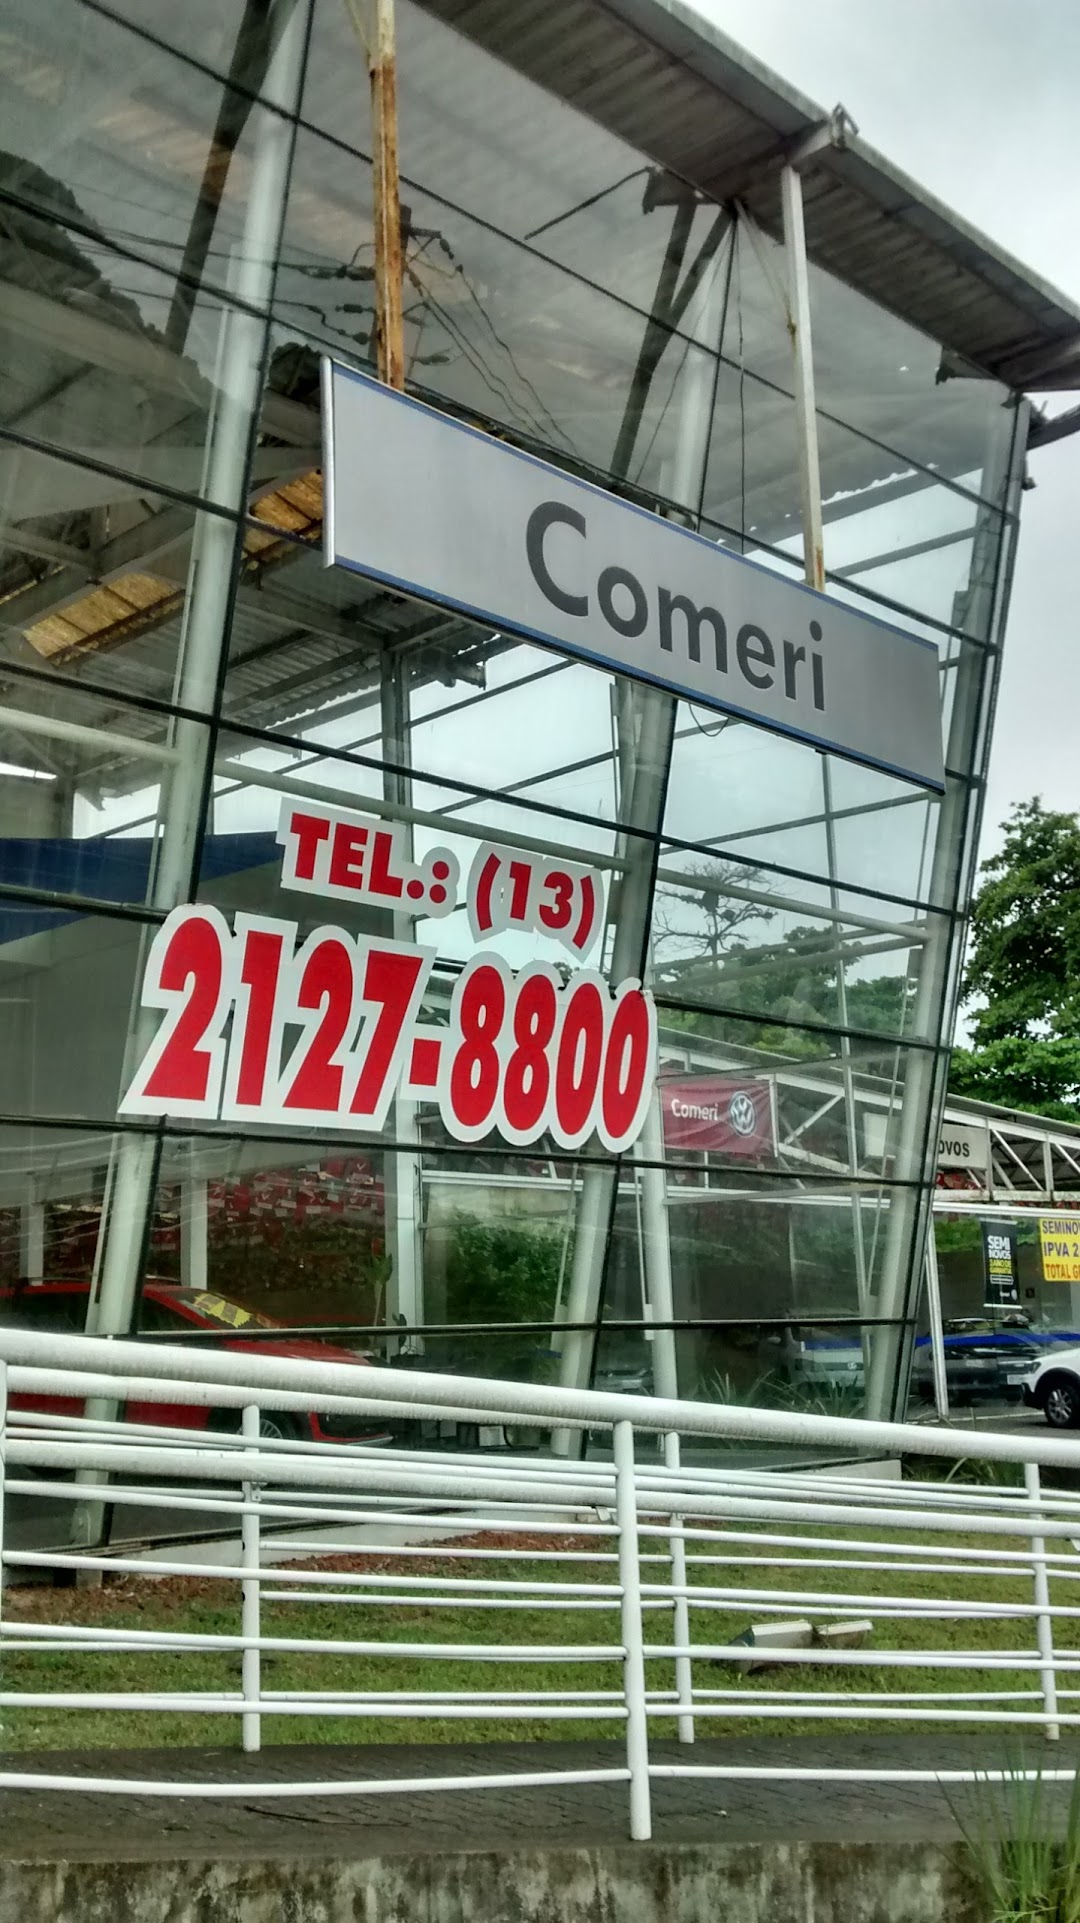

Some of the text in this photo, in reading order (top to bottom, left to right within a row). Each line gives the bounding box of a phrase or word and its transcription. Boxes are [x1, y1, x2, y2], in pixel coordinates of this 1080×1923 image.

[526, 501, 825, 711] Comeri
[290, 812, 595, 950] TEL.: (13)
[142, 917, 649, 1139] 2127-8800
[671, 1098, 719, 1121] Comeri
[1042, 1220, 1080, 1236] SEMINO
[988, 1235, 1011, 1251] SEMI
[1044, 1241, 1070, 1257] IPVA
[989, 1249, 1012, 1260] NOVOS
[1045, 1263, 1072, 1279] TOTAL
